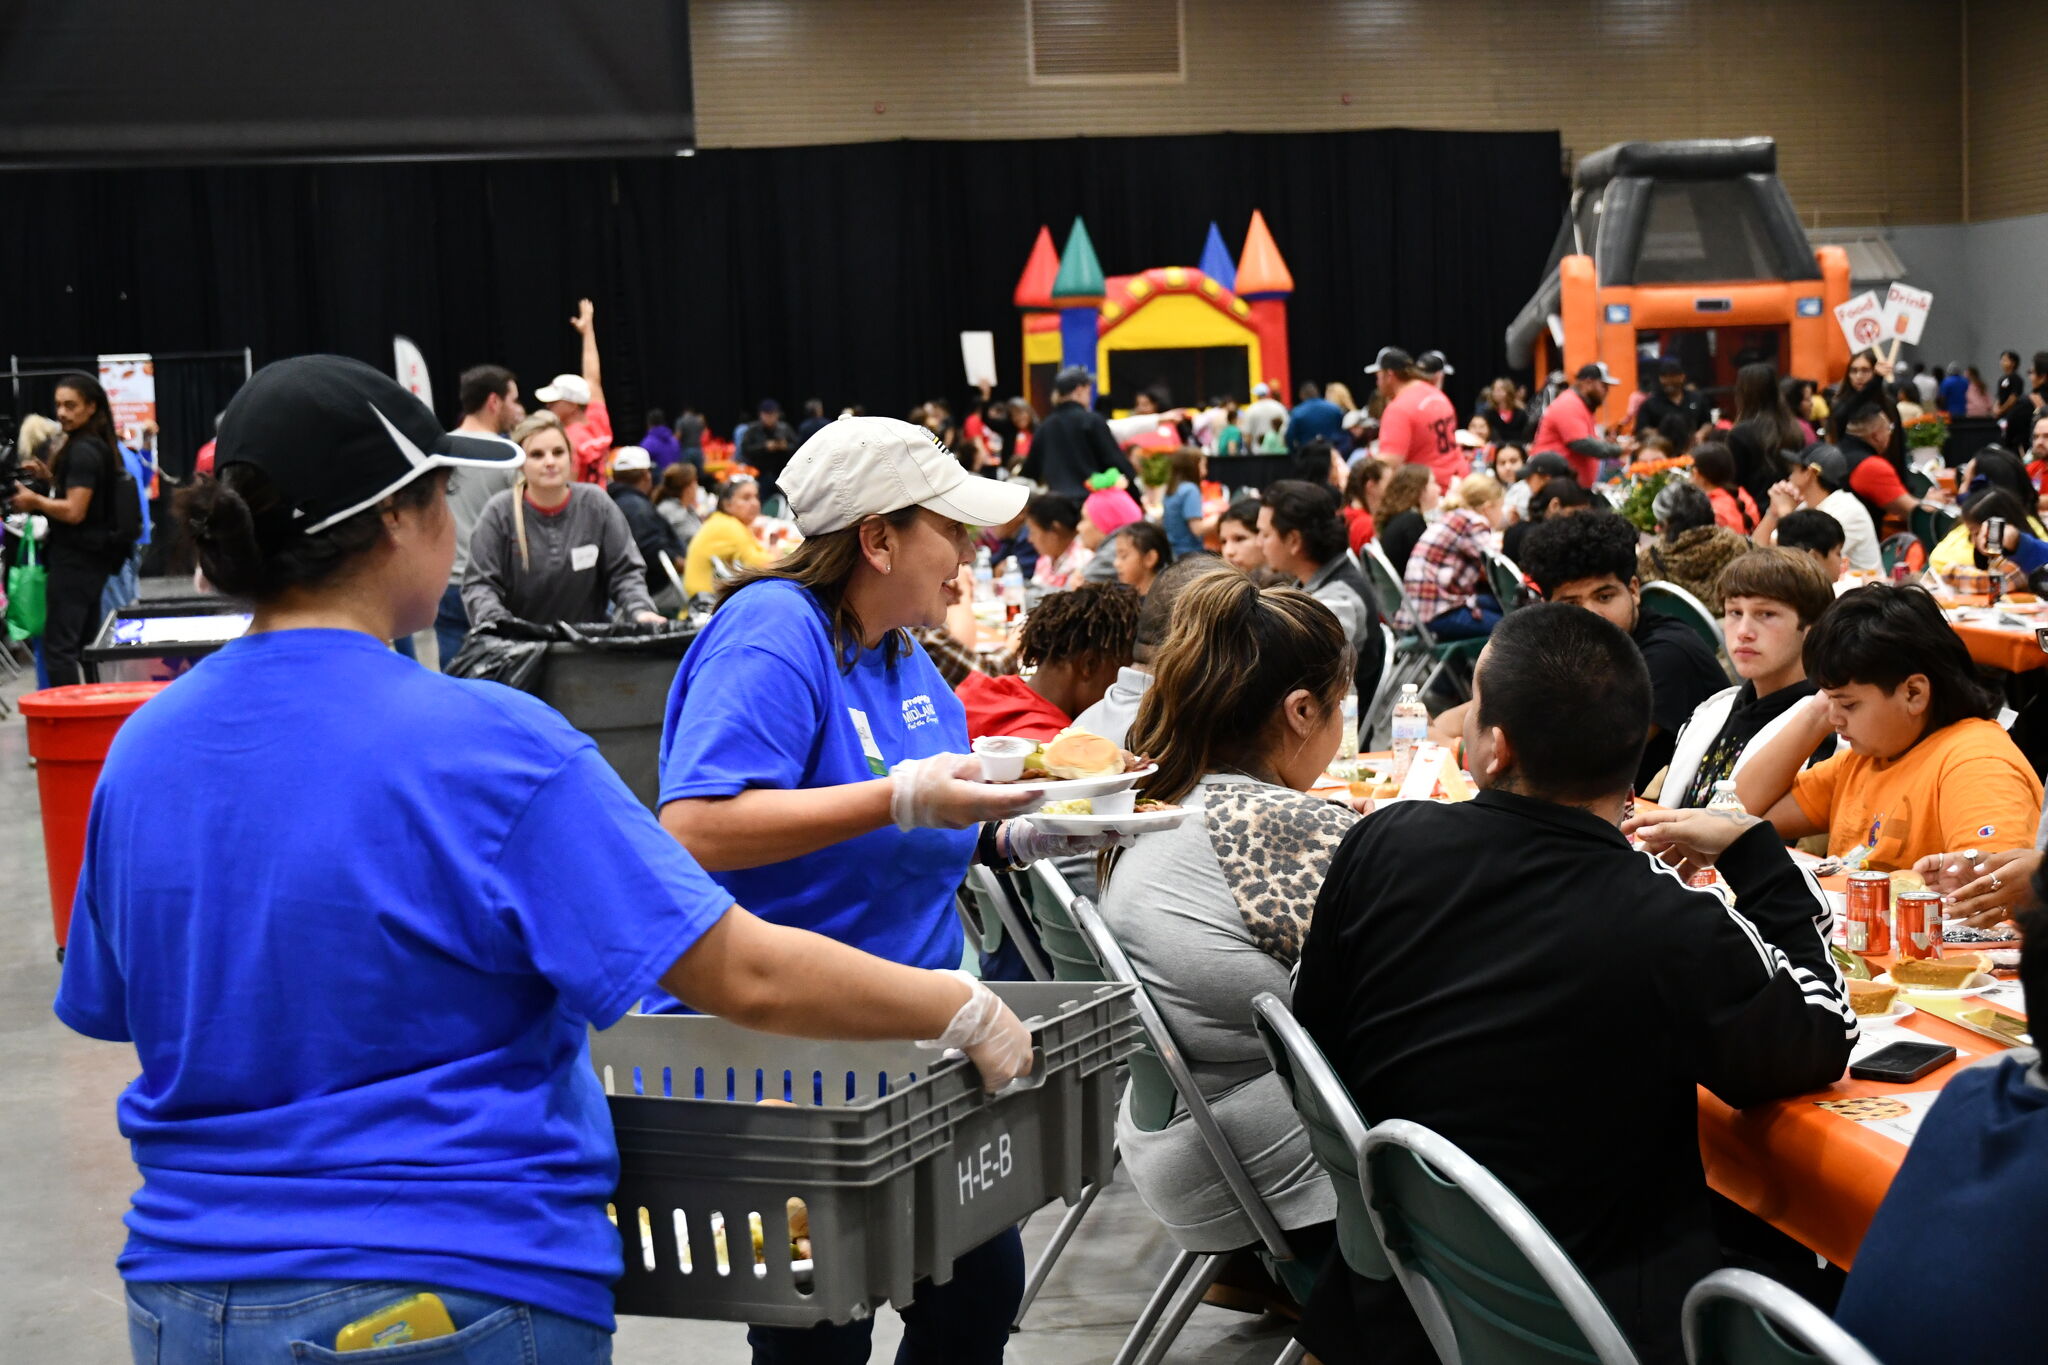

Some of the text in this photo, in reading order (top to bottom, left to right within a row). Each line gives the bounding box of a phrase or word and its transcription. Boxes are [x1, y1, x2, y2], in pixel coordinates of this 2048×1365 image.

[1836, 296, 1874, 321] Food
[1888, 288, 1929, 311] Drink
[957, 1132, 1013, 1206] H-E-B
